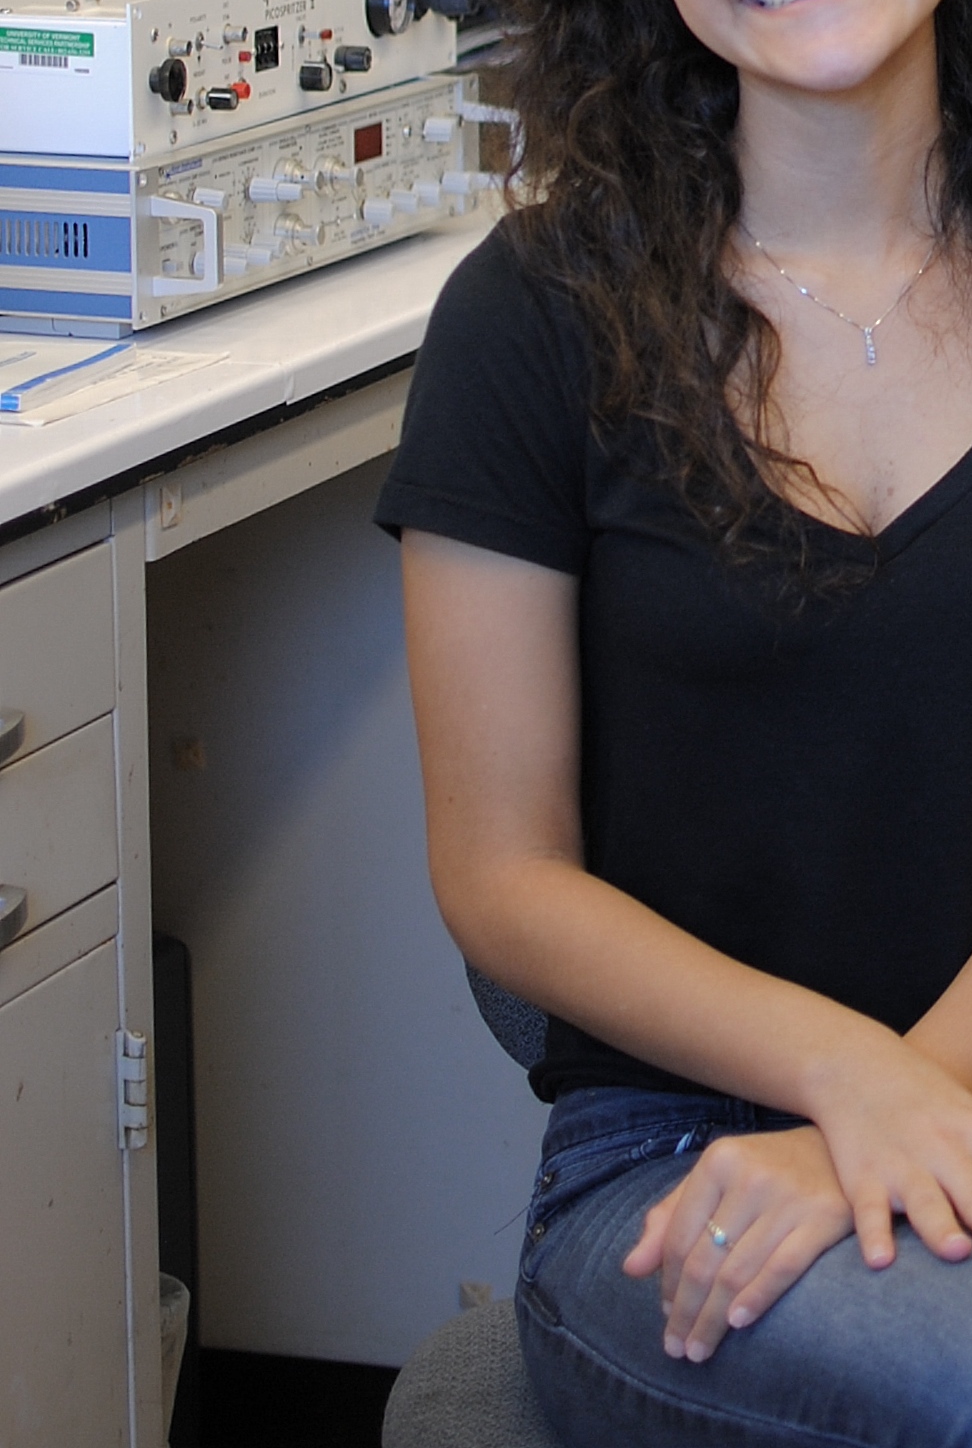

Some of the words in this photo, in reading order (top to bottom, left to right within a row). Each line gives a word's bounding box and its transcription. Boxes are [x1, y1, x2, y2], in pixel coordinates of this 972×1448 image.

[6, 30, 41, 39] UNIVERSITY
[42, 32, 50, 40] OF
[52, 33, 80, 42] VERMONT
